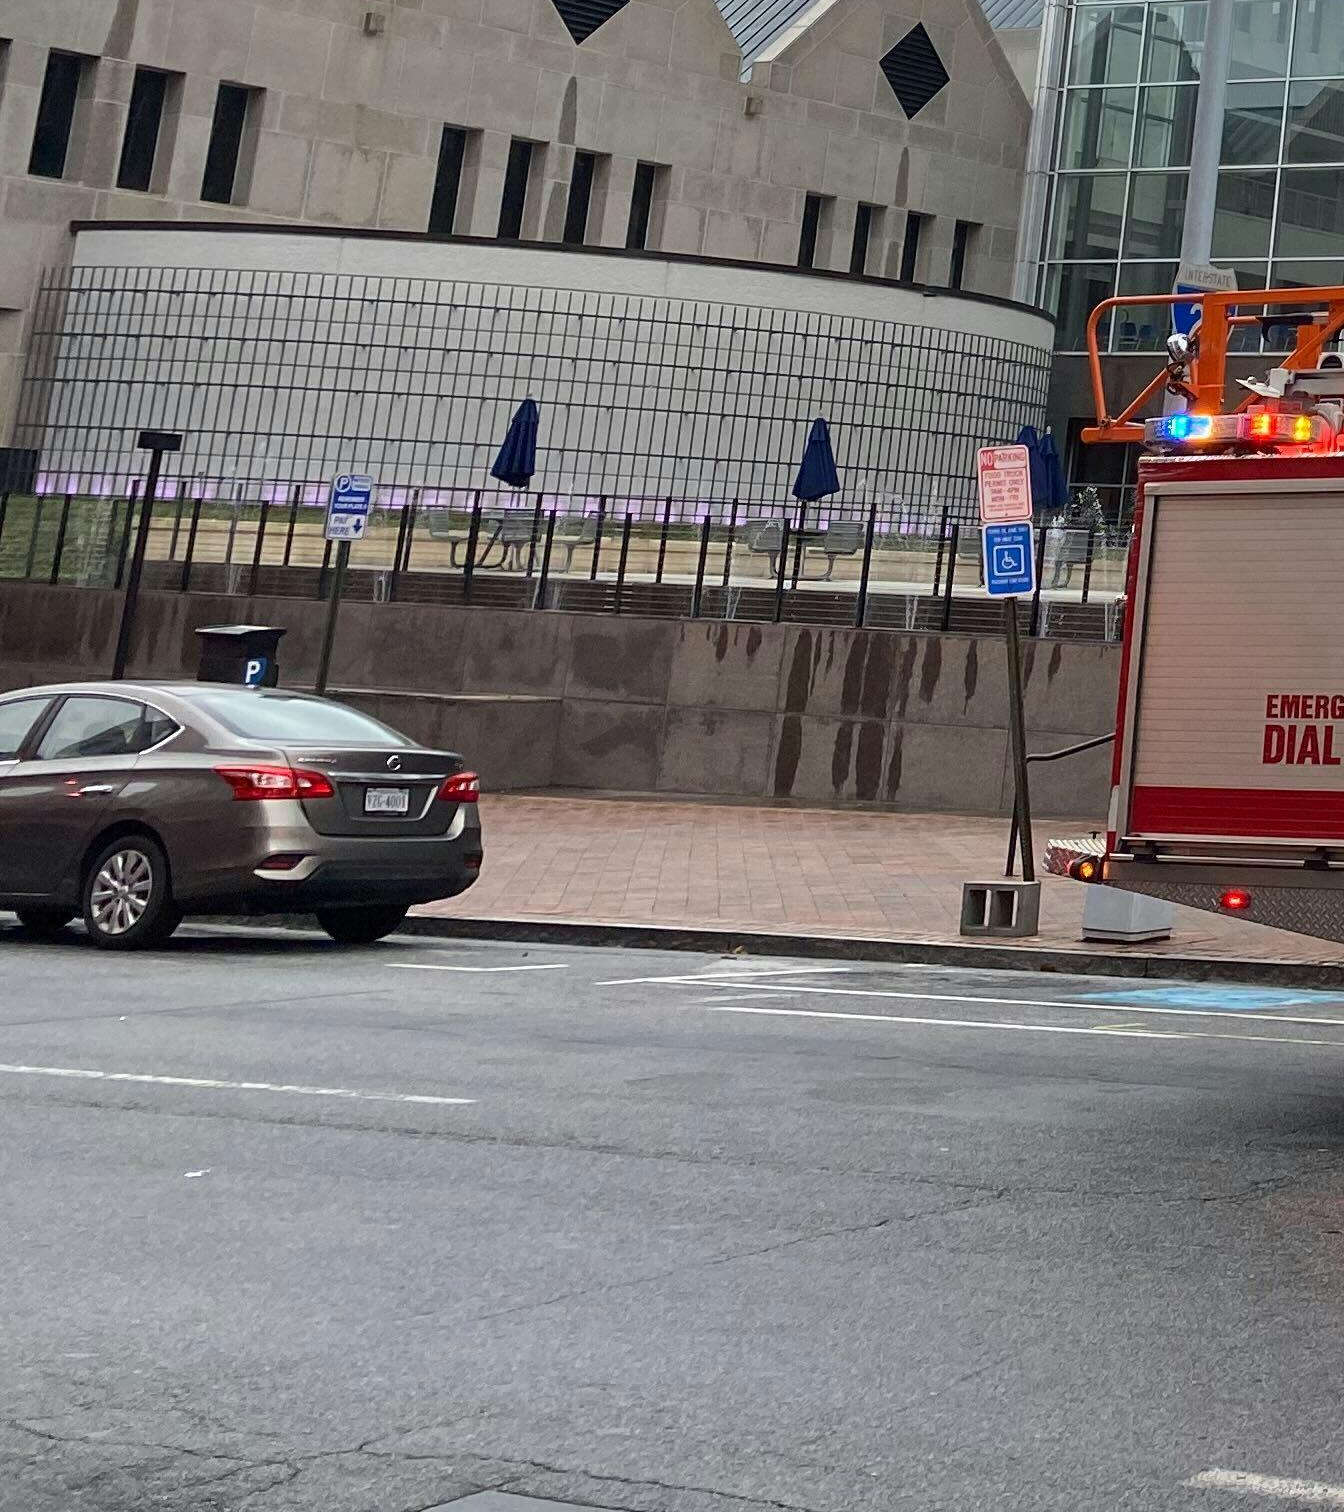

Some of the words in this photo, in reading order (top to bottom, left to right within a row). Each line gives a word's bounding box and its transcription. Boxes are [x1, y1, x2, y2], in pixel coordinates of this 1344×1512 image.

[1184, 269, 1232, 287] INTERSTATE
[980, 451, 994, 467] NO
[994, 452, 1025, 463] PARKING
[1262, 724, 1341, 765] DIAL
